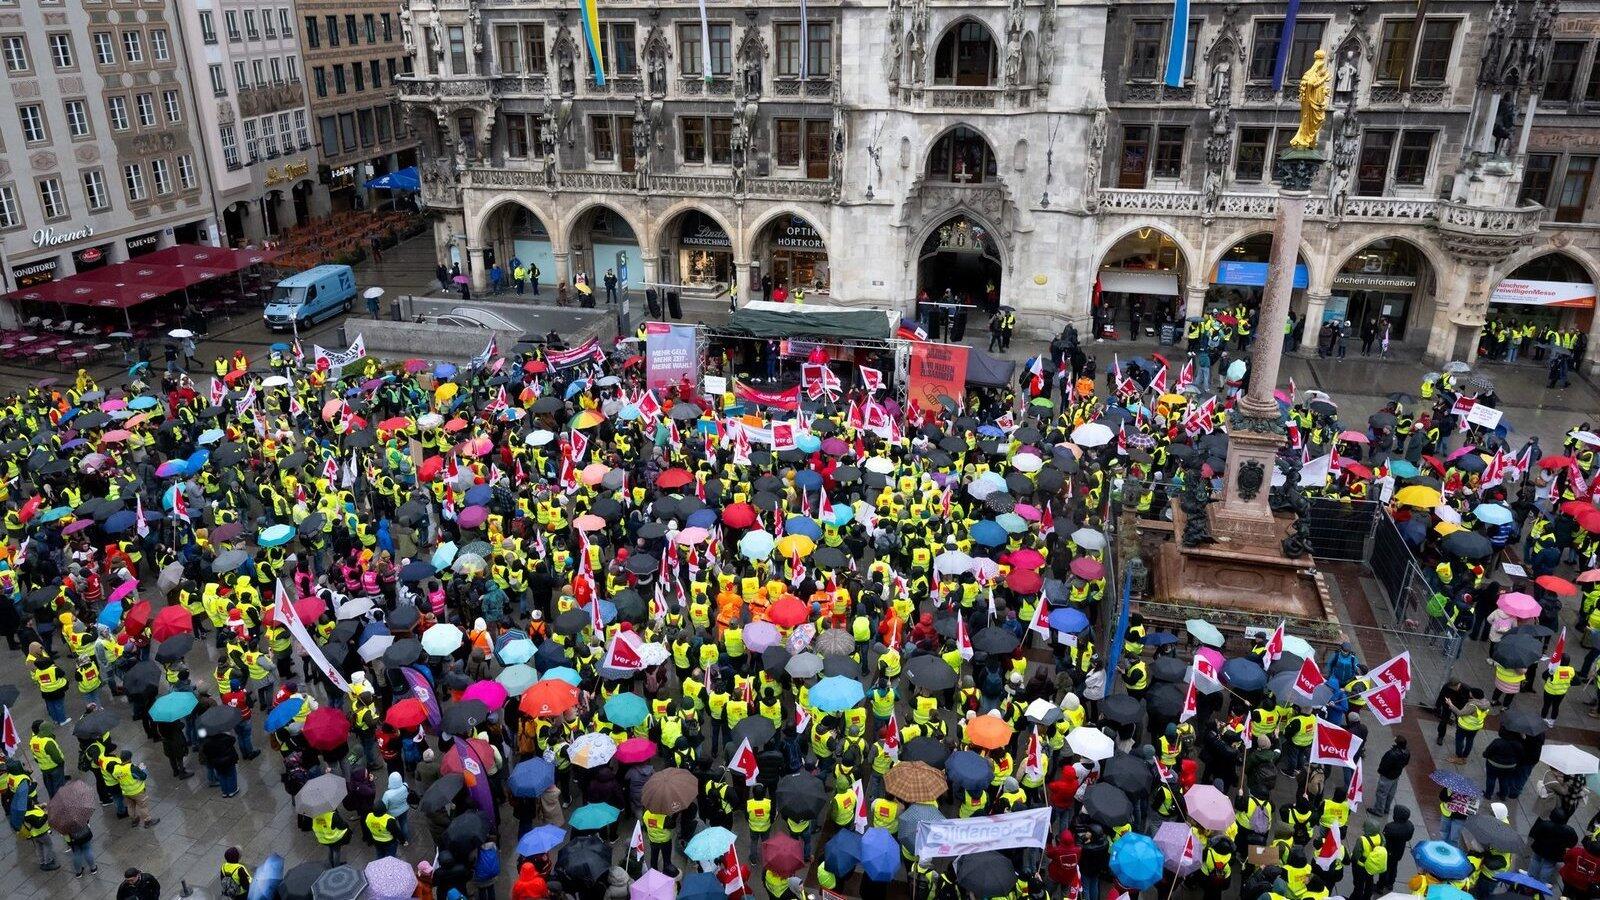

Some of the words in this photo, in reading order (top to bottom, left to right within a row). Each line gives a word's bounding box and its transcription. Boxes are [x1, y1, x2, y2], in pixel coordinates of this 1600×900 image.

[33, 225, 94, 247] Woerner's
[786, 226, 818, 236] OPTIK
[1368, 278, 1416, 288] Information
